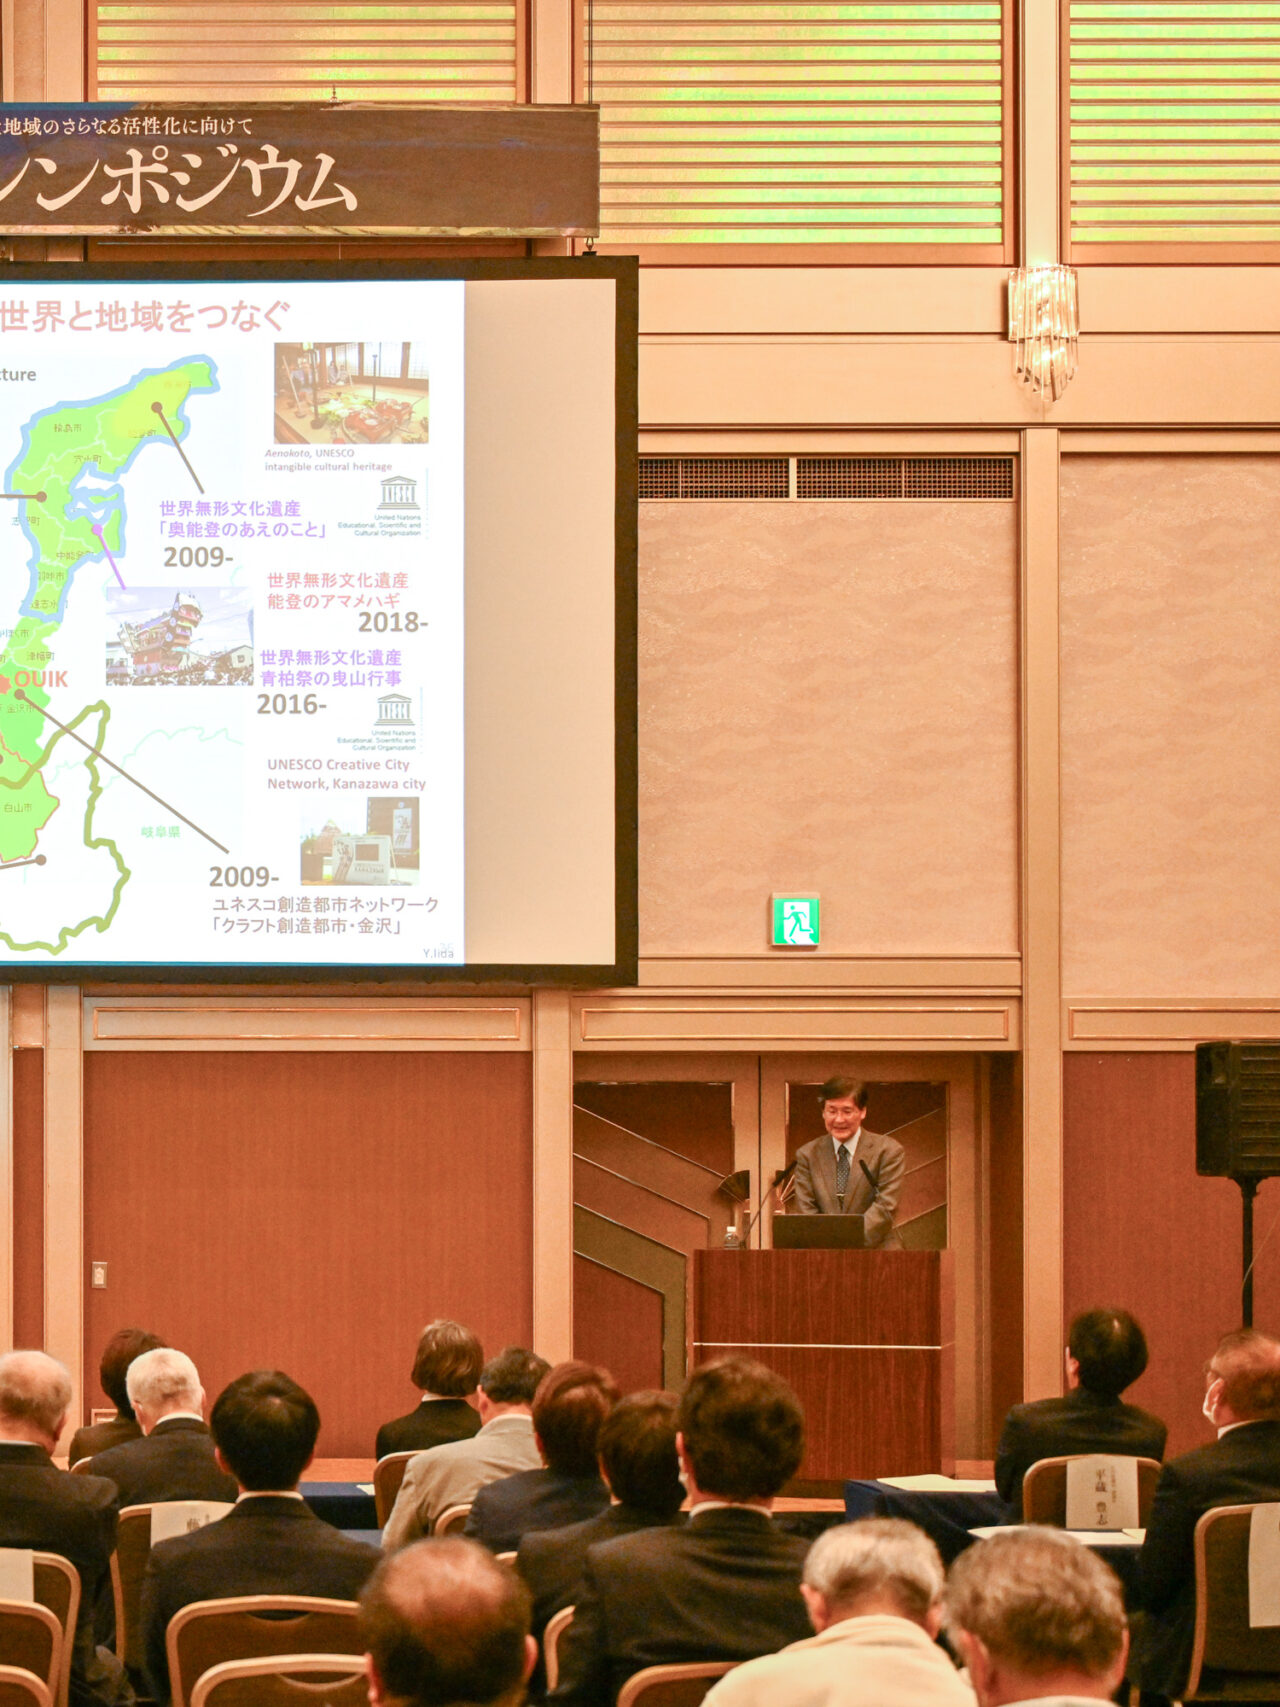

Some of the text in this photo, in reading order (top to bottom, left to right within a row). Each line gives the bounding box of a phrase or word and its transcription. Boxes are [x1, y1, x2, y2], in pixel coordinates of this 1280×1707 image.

[265, 449, 354, 459] Aenokoto, UNESCO
[265, 462, 392, 472] intangible cultural heritage
[160, 500, 301, 517] 世界無形文化遺産
[160, 521, 325, 538] 「奥能登のあえのこと」
[164, 547, 233, 567] 2009-
[267, 571, 408, 589] 世界無形文化遺産
[267, 593, 400, 609] 能登のアマメハギ
[359, 612, 428, 632] 2018-
[260, 649, 401, 666] 世界無形文化遺産
[14, 670, 68, 688] OUIK
[260, 670, 401, 687] 青柏祭の曳山行事
[257, 694, 326, 715] 2016-
[268, 759, 410, 772] UNESCO Creative City
[268, 778, 426, 791] Network, Kanazawa city
[210, 866, 279, 887] 2009-
[213, 896, 438, 913] ユネスコ創造都市ネットワーク
[214, 917, 400, 934] 「クラフト創造都市・金沢」
